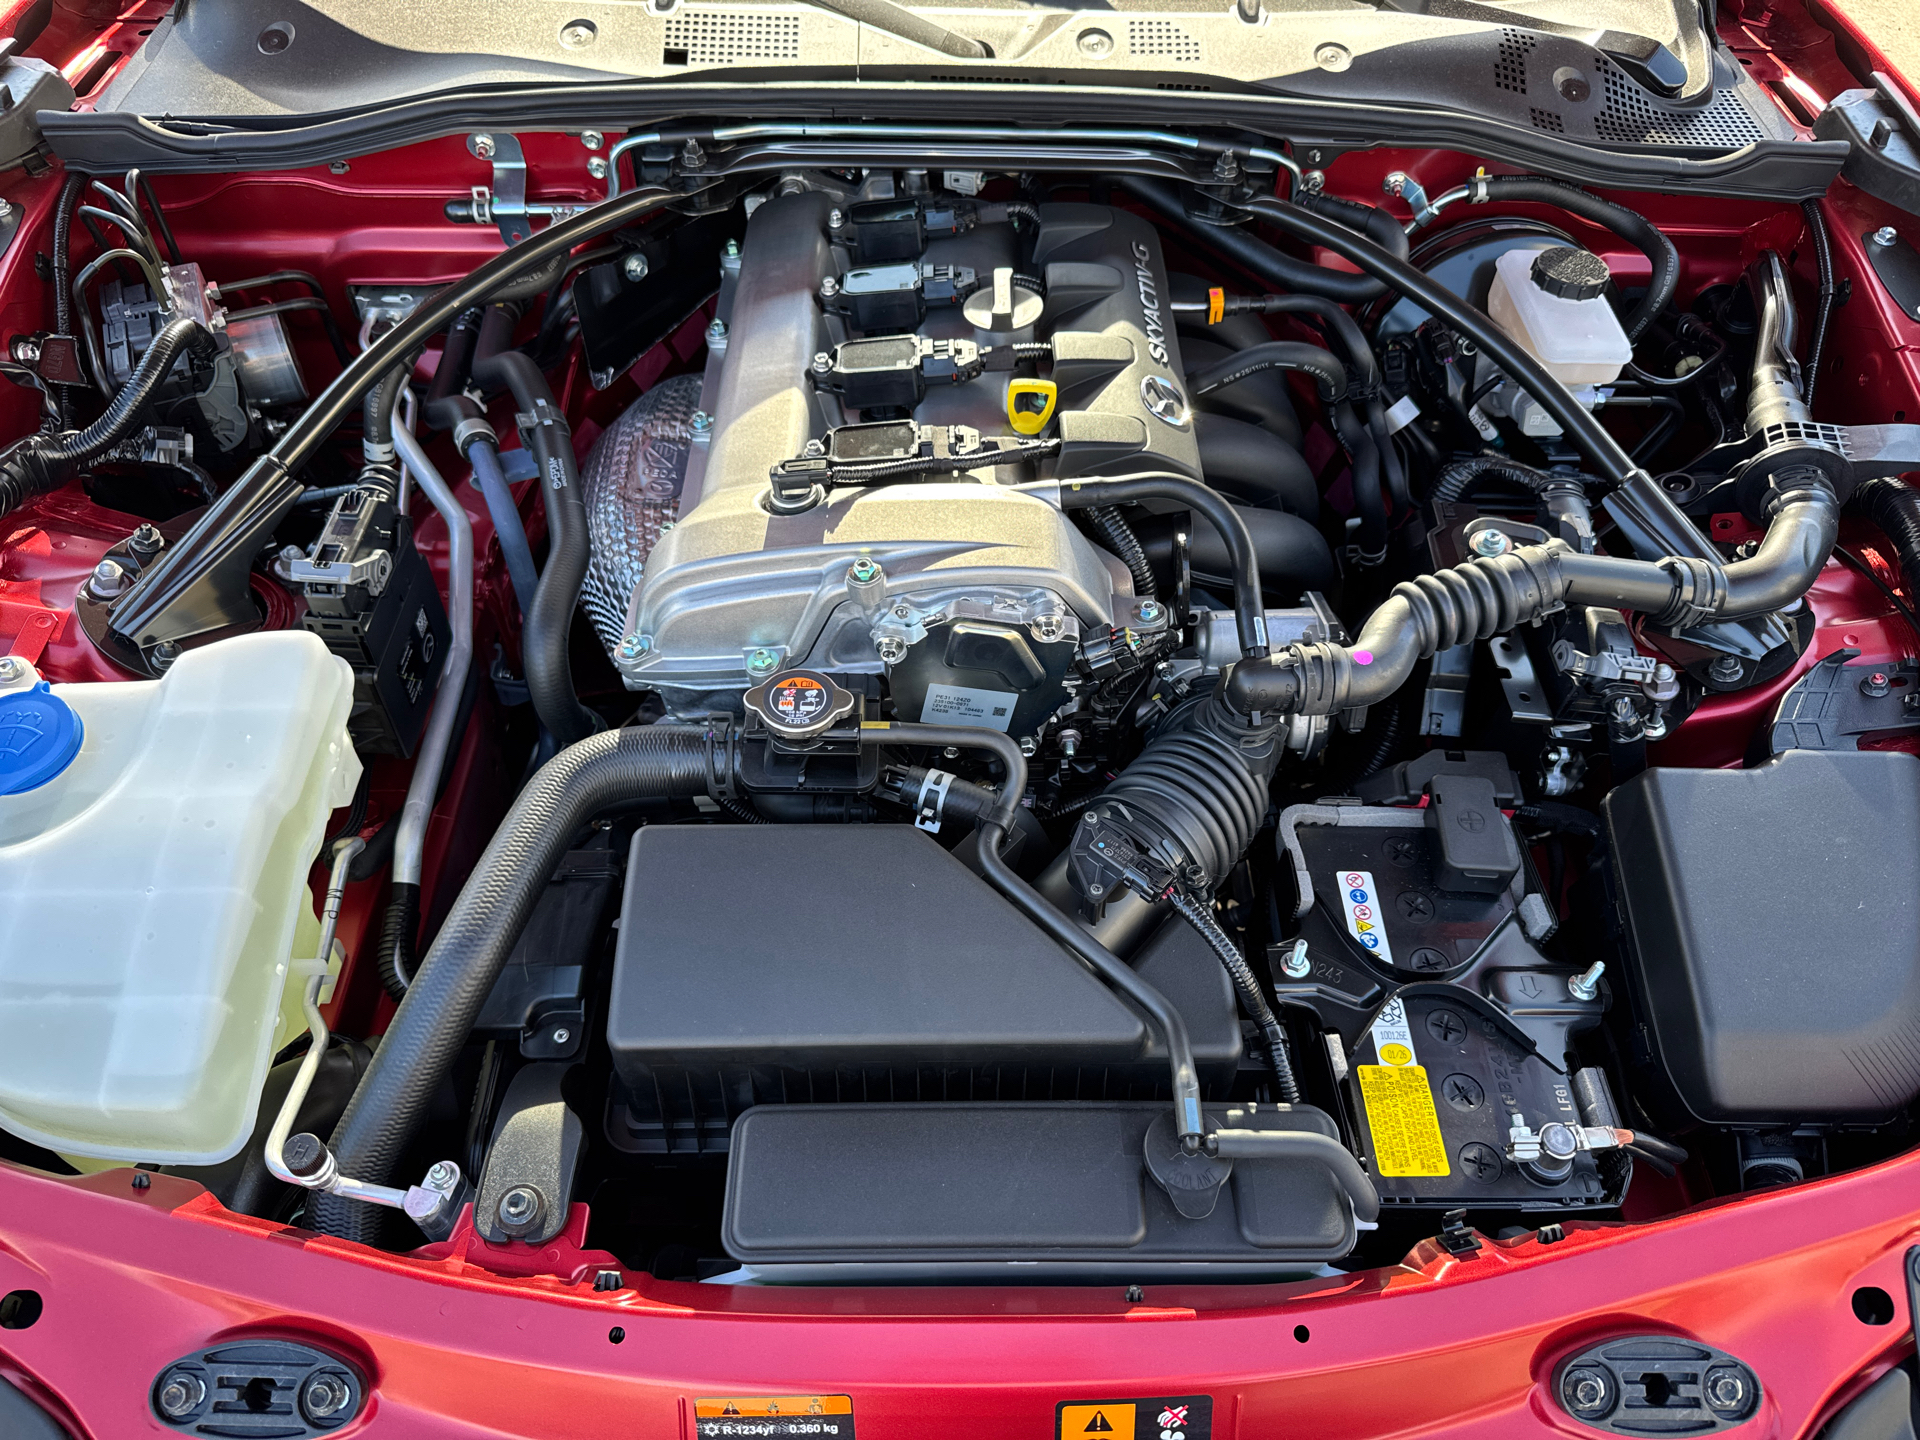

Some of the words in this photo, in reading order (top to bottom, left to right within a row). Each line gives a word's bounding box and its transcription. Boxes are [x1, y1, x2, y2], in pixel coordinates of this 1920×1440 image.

[1131, 241, 1169, 365] SKYACTIV-G
[1223, 375, 1235, 384] NS
[1387, 1049, 1407, 1059] 01/26
[1386, 1081, 1399, 1108] POISON
[1395, 1080, 1403, 1092] KEEP
[1418, 1084, 1434, 1117] DANGER
[1552, 1084, 1573, 1112] LFG1
[1368, 1081, 1376, 1093] KEEP
[1374, 1111, 1384, 1128] REACH
[1379, 1136, 1391, 1161] CHILDREN
[1392, 1110, 1402, 1129] CAUSES
[1400, 1106, 1409, 1119] CAPS
[1403, 1120, 1412, 1134] TIGHT
[1427, 1118, 1440, 1145] EXPLOSIVE
[1397, 1130, 1407, 1149] SEVERE
[292, 1143, 309, 1160] H
[1401, 1150, 1411, 1168] BURNS
[1410, 1146, 1418, 1161] LEVEL
[1433, 1146, 1444, 1162] GASES
[1167, 1167, 1217, 1189] COOLANT
[722, 1424, 775, 1437] R-1234yf
[789, 1424, 821, 1434] 0.360
[823, 1423, 839, 1434] kg
